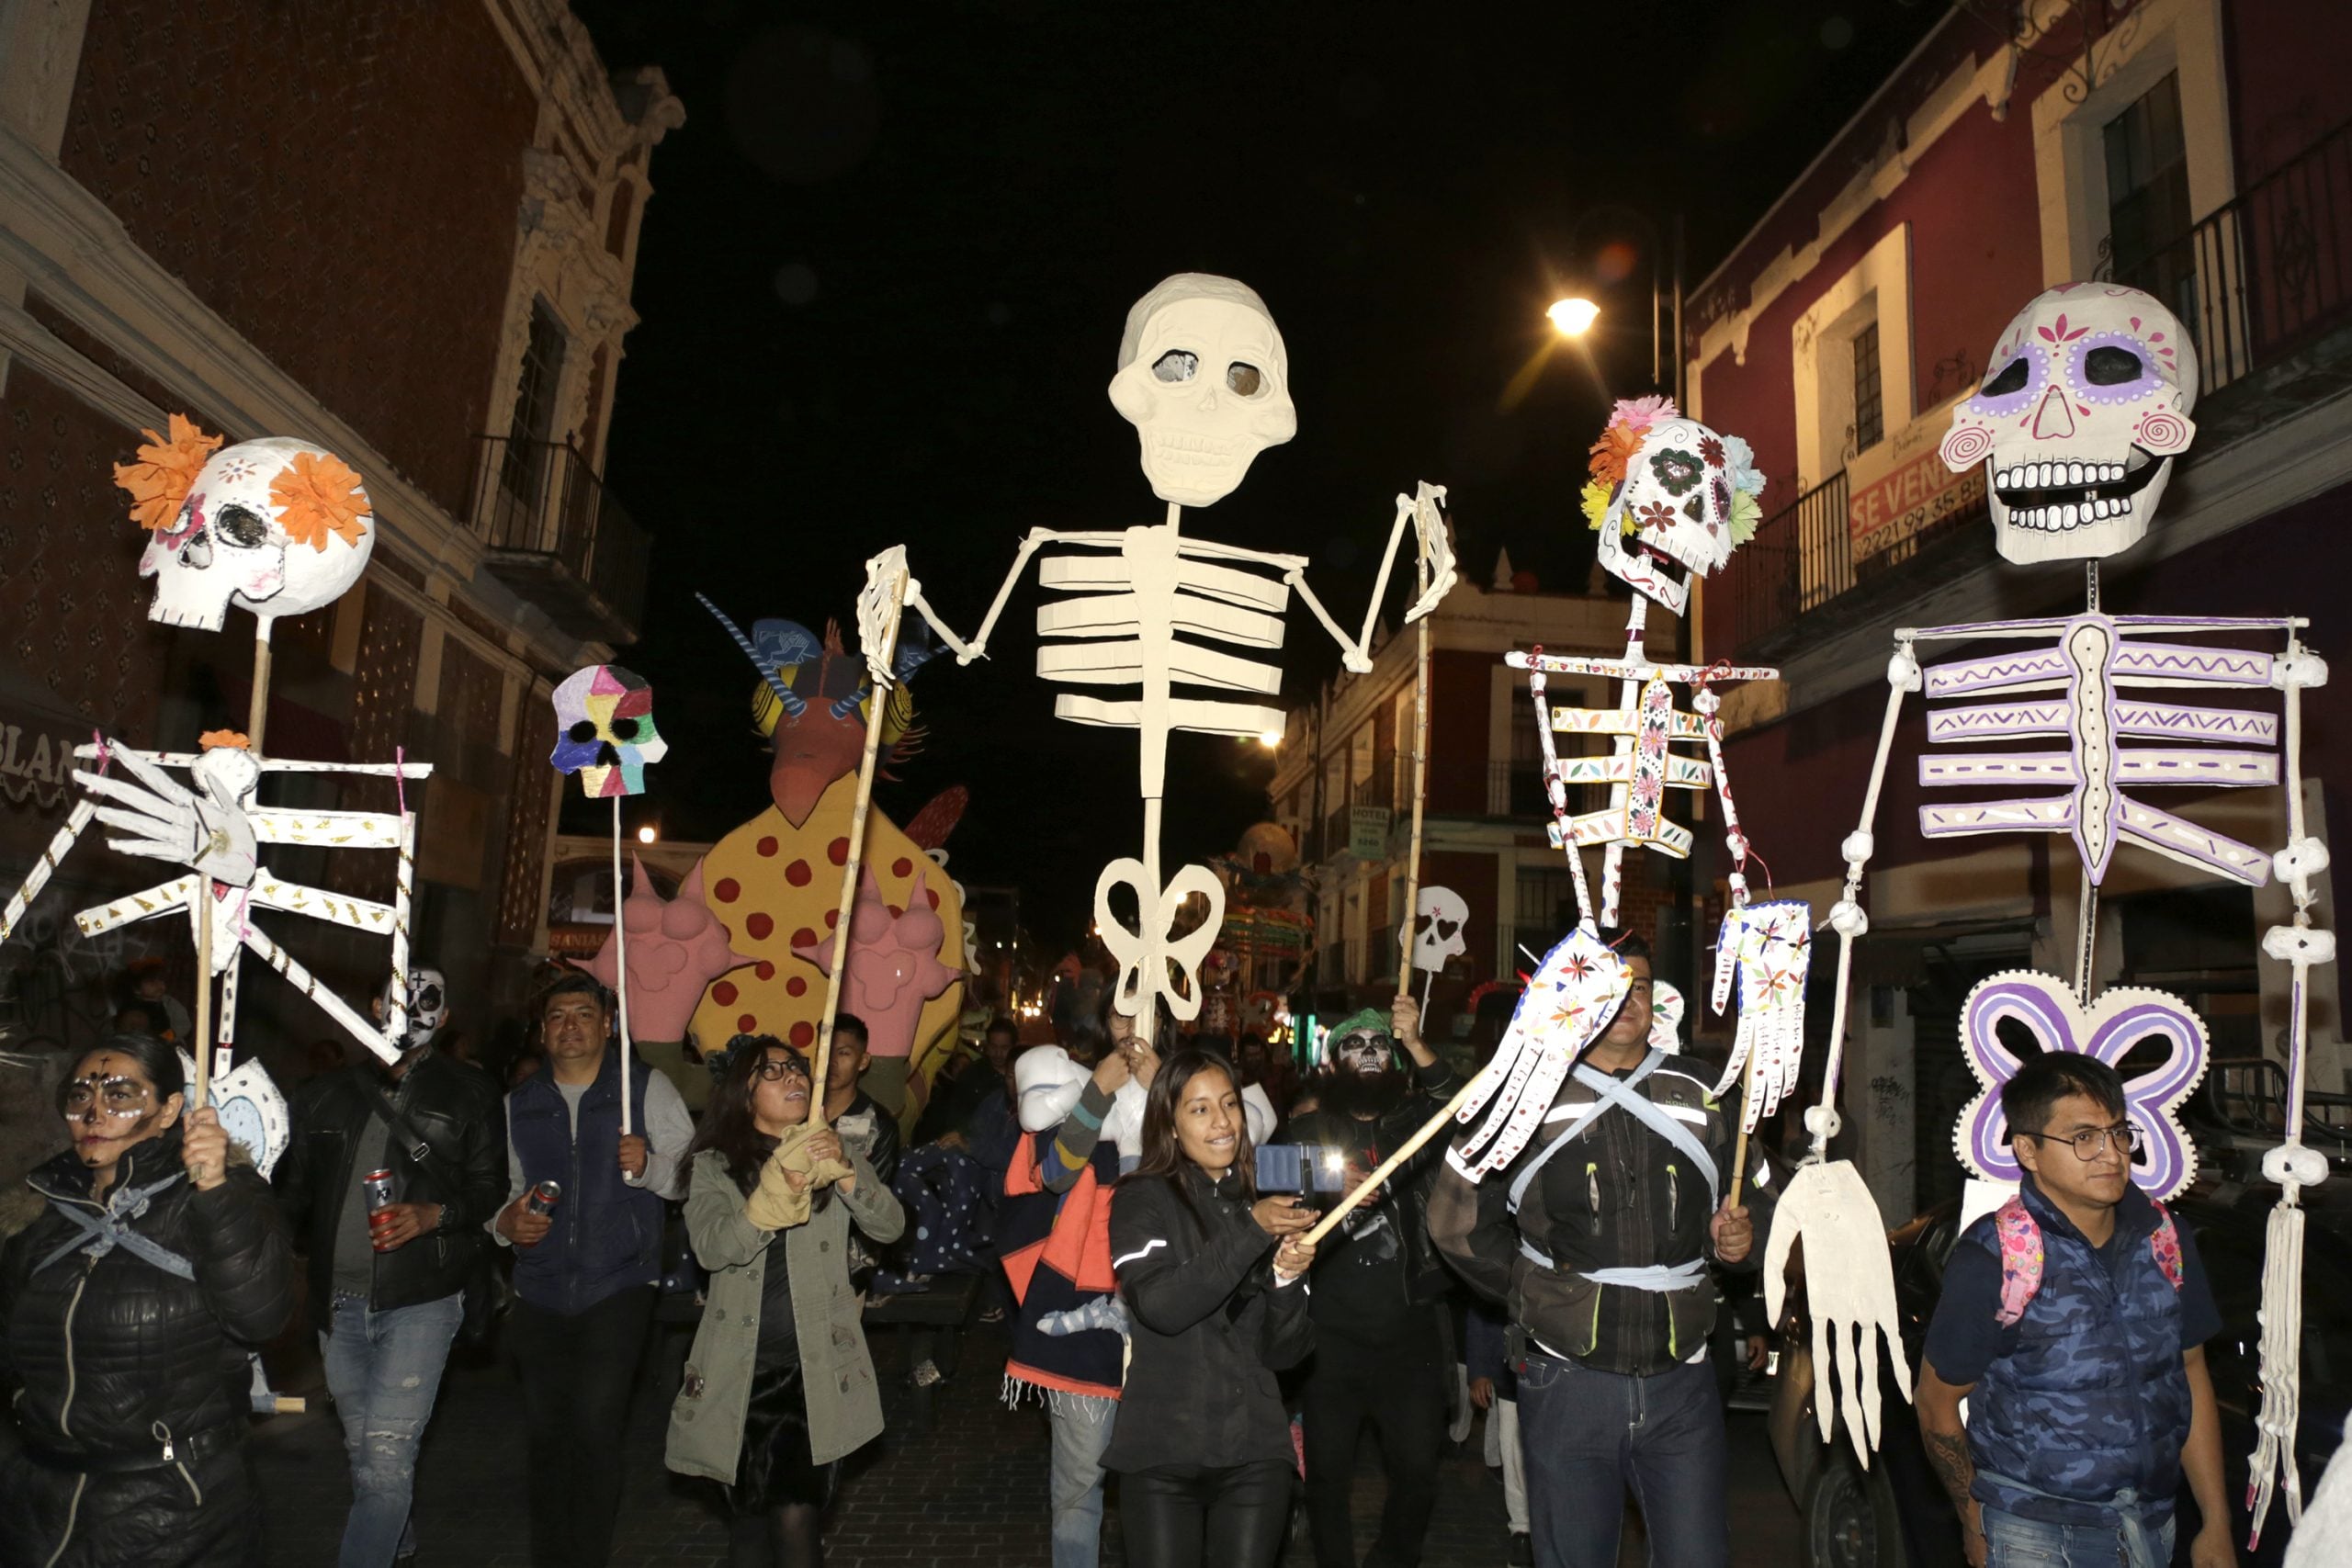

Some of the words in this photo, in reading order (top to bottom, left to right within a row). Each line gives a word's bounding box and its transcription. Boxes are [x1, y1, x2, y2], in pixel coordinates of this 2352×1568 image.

[1851, 490, 1880, 533] SE
[1884, 456, 1952, 515] VEN
[1904, 507, 1925, 533] 99
[1932, 490, 1954, 518] 35
[1353, 809, 1387, 820] HOTEL
